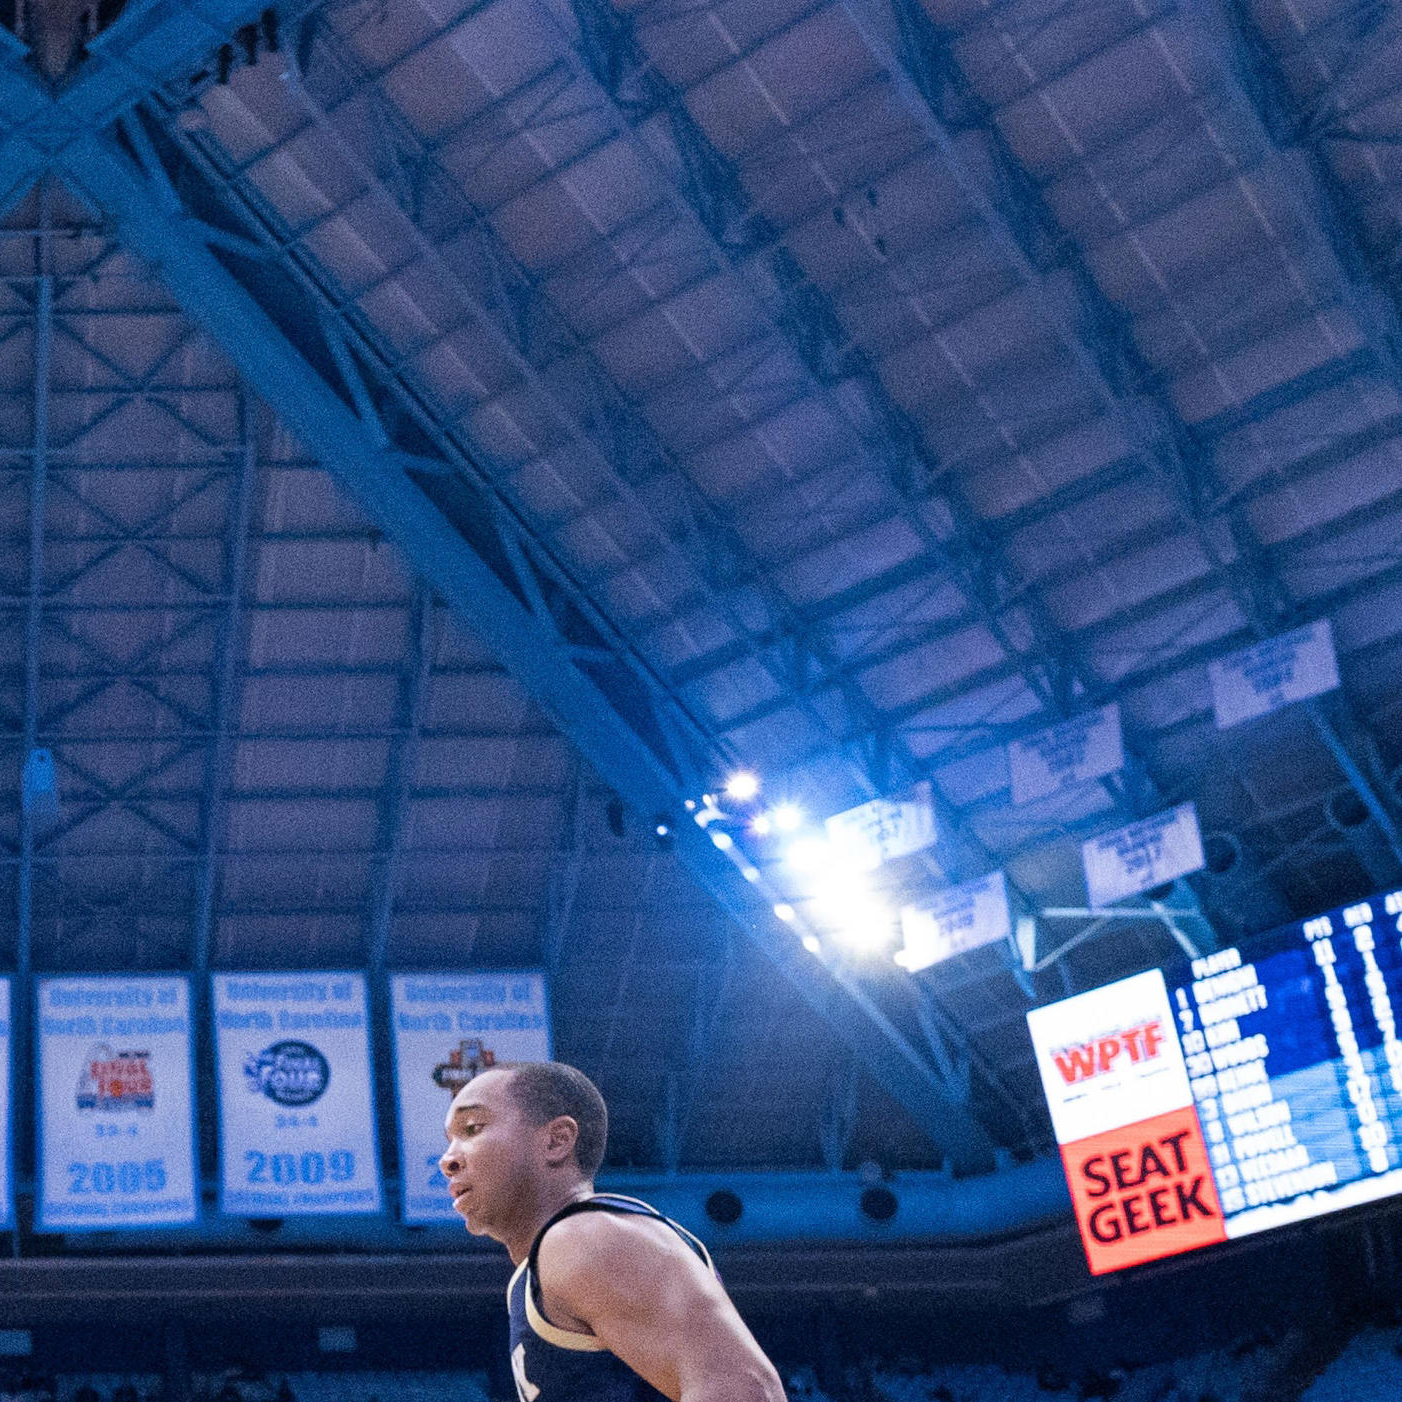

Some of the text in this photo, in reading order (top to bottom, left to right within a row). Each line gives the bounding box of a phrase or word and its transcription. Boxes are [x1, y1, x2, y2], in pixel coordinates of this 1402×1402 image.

[1053, 1020, 1166, 1087] WPTF
[67, 1158, 168, 1195] 2005
[244, 1149, 356, 1185] 2009
[1081, 1130, 1191, 1199] SEAT
[1090, 1174, 1215, 1244] GEEK
